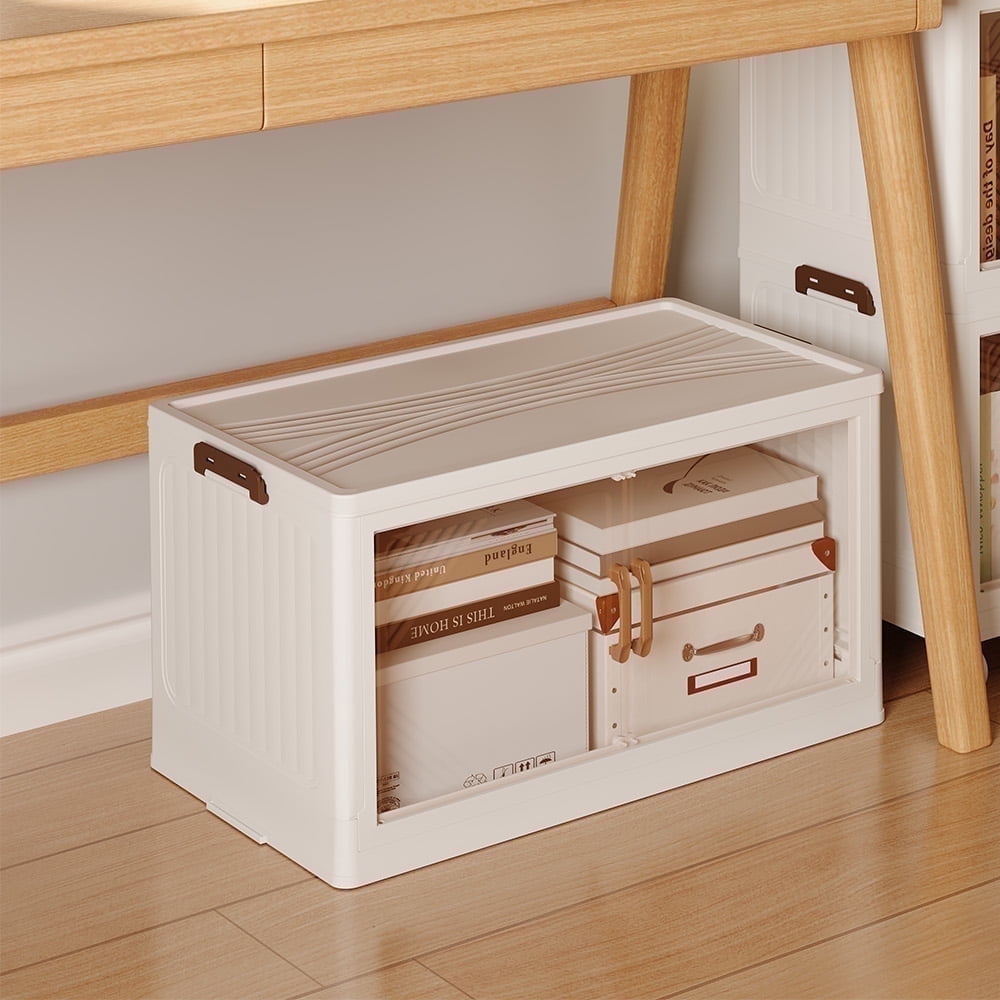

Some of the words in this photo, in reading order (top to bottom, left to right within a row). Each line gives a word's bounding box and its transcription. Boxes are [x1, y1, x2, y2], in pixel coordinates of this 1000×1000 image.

[484, 542, 533, 567] England
[376, 573, 411, 589] Kingdo
[414, 564, 446, 582] United
[466, 605, 496, 623] THIS
[503, 601, 525, 611] WALTON
[410, 618, 450, 640] HOME
[452, 614, 464, 628] IS
